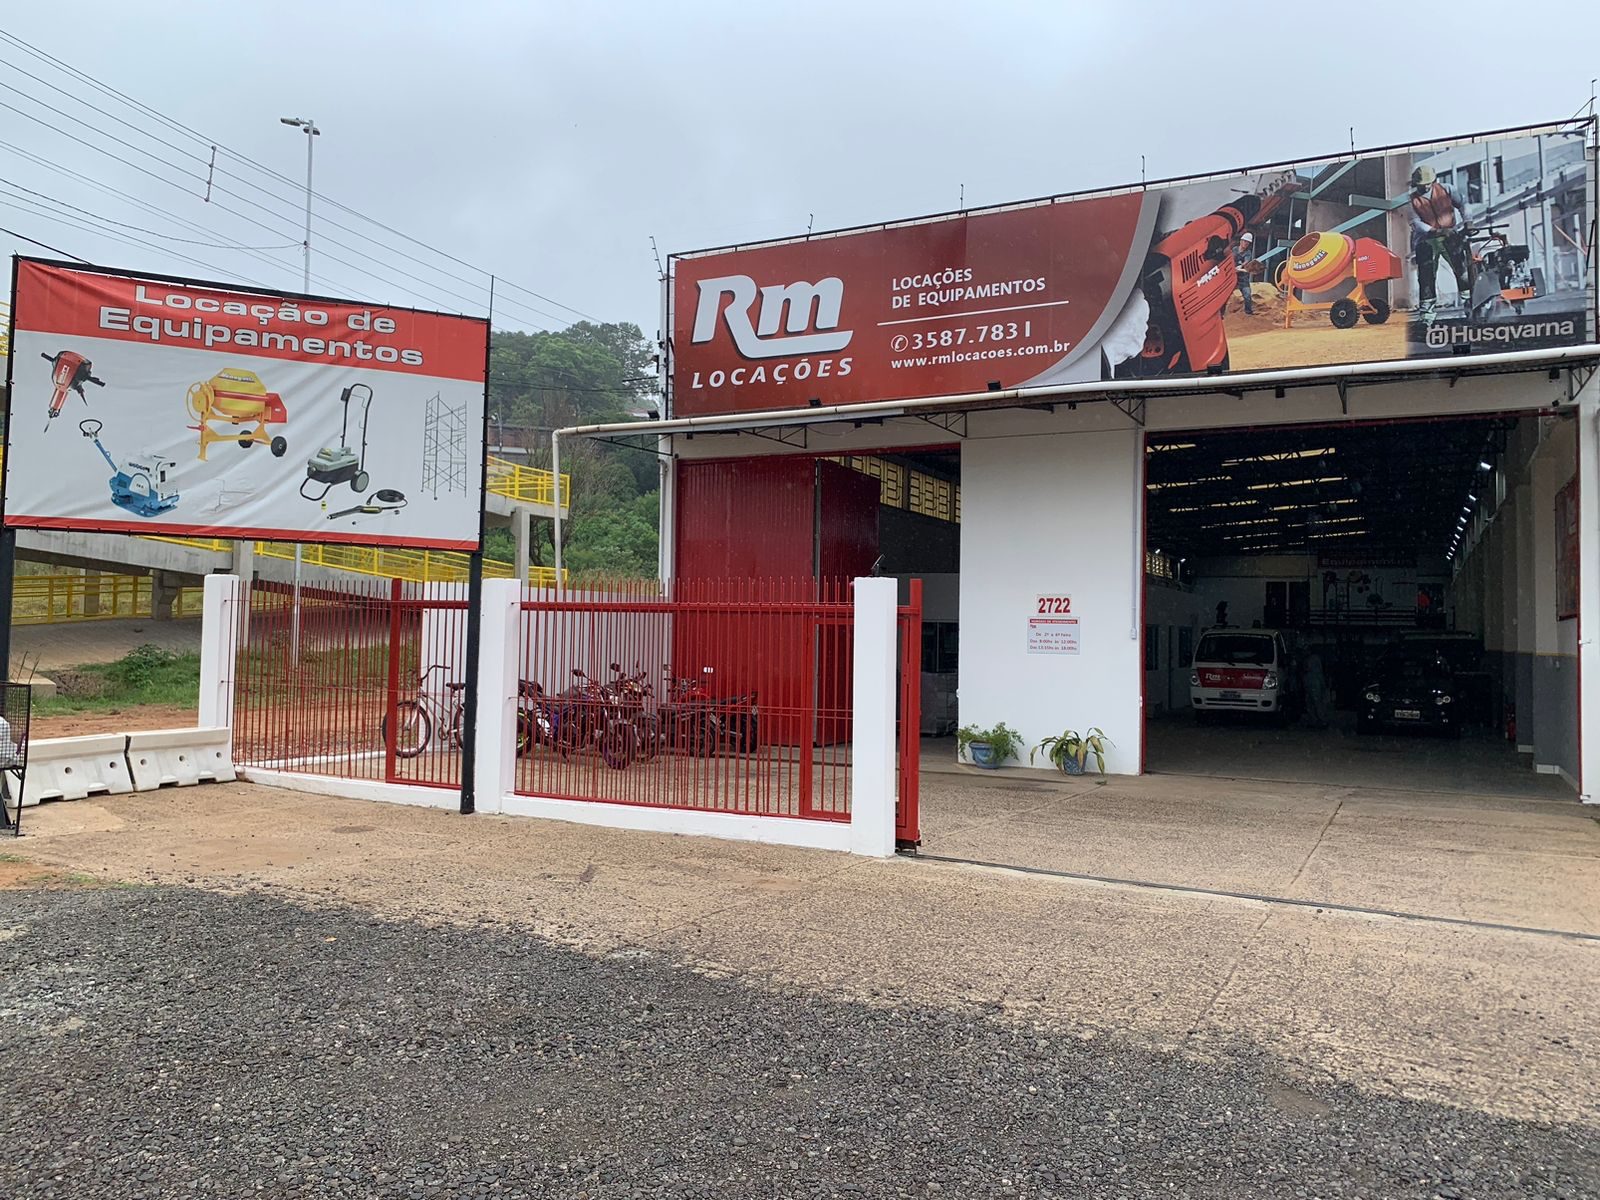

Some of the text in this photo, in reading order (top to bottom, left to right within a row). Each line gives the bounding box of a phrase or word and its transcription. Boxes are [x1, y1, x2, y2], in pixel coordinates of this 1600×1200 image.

[892, 277, 1046, 309] DE EQUIPAMENTOS
[893, 268, 973, 291] LOCAÇÕES
[135, 284, 397, 334] Locação de
[99, 305, 424, 366] Equipamentos
[912, 321, 1032, 350] 3587.7831
[1451, 319, 1575, 346] Husqvarna
[891, 340, 1071, 369] www.rmlocacoes.com.br
[691, 357, 854, 389] LOCAÇÕES
[1038, 598, 1070, 613] 2722
